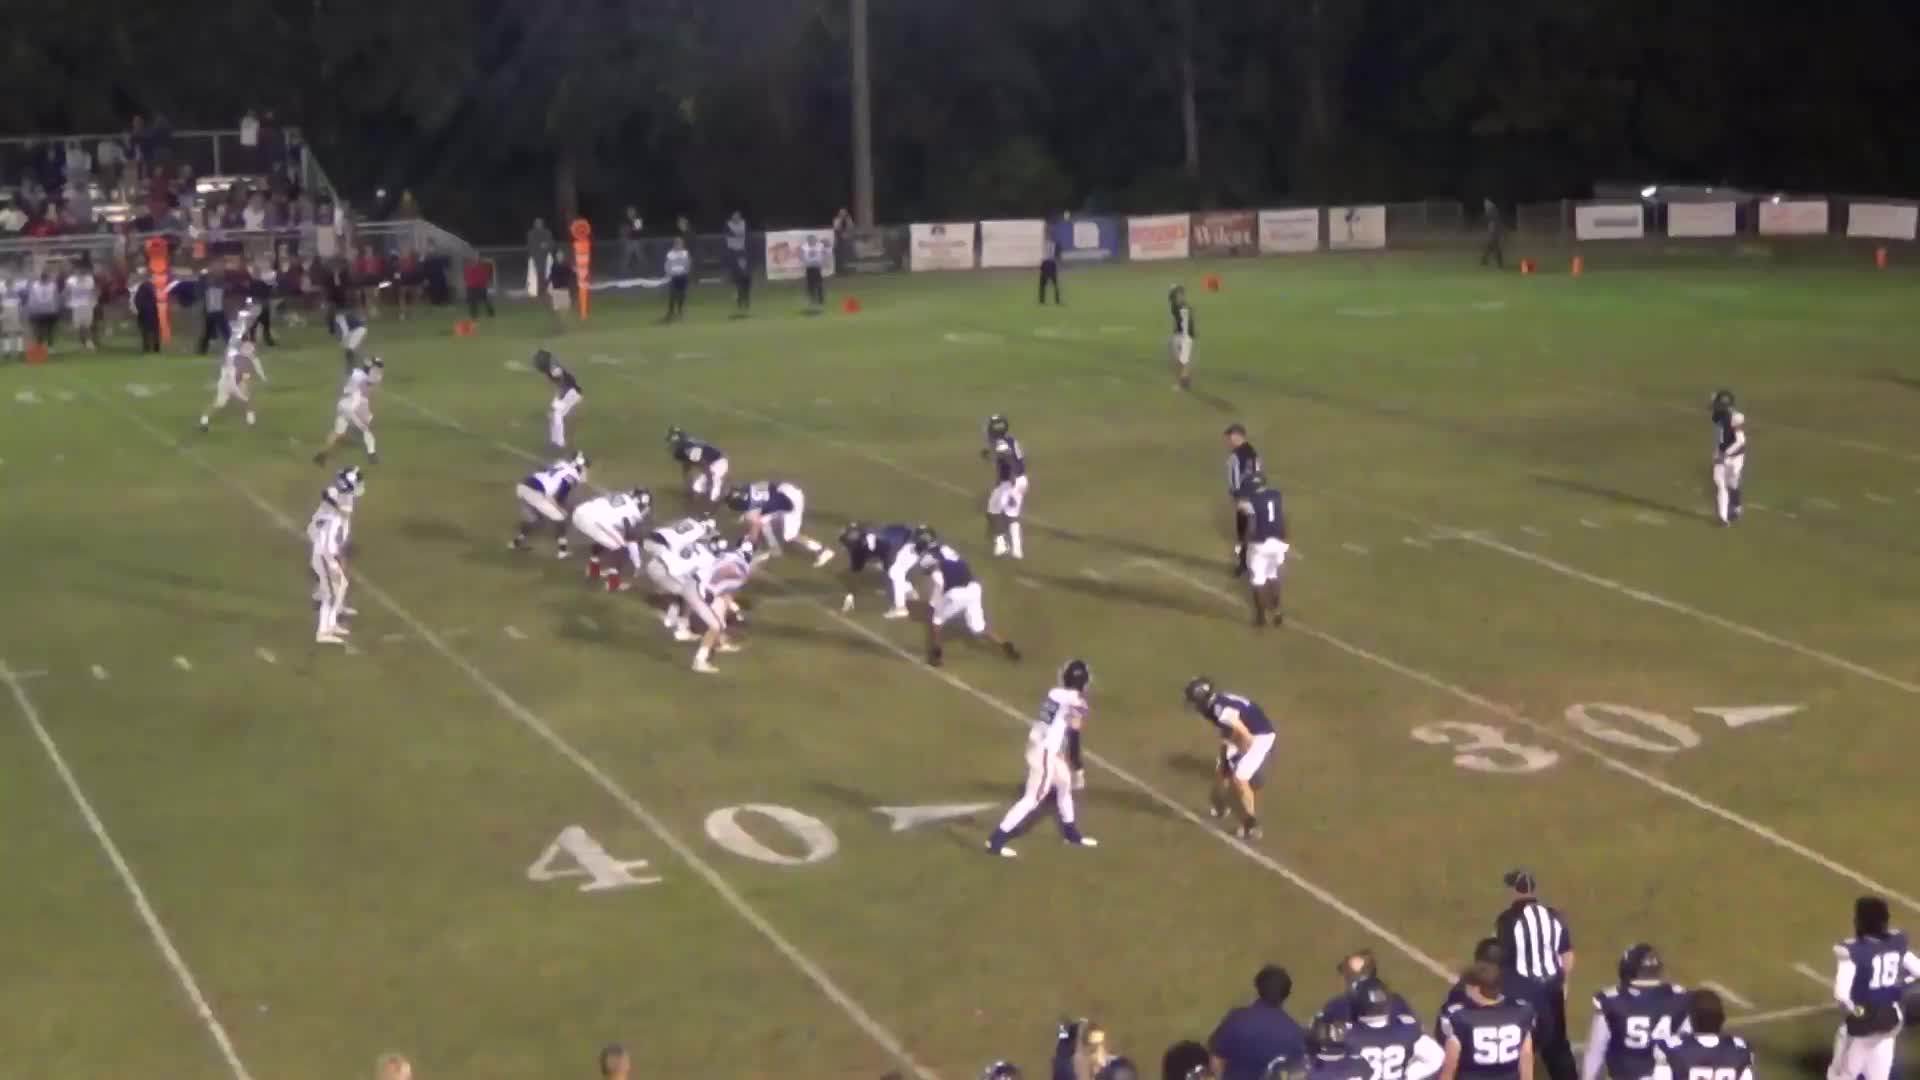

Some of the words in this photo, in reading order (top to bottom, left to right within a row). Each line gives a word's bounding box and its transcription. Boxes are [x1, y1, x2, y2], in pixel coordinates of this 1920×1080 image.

[1267, 499, 1276, 523] 1
[1410, 703, 1700, 772] 30
[527, 803, 839, 892] 40
[1473, 1023, 1521, 1065] 52
[1624, 1015, 1676, 1048] 54
